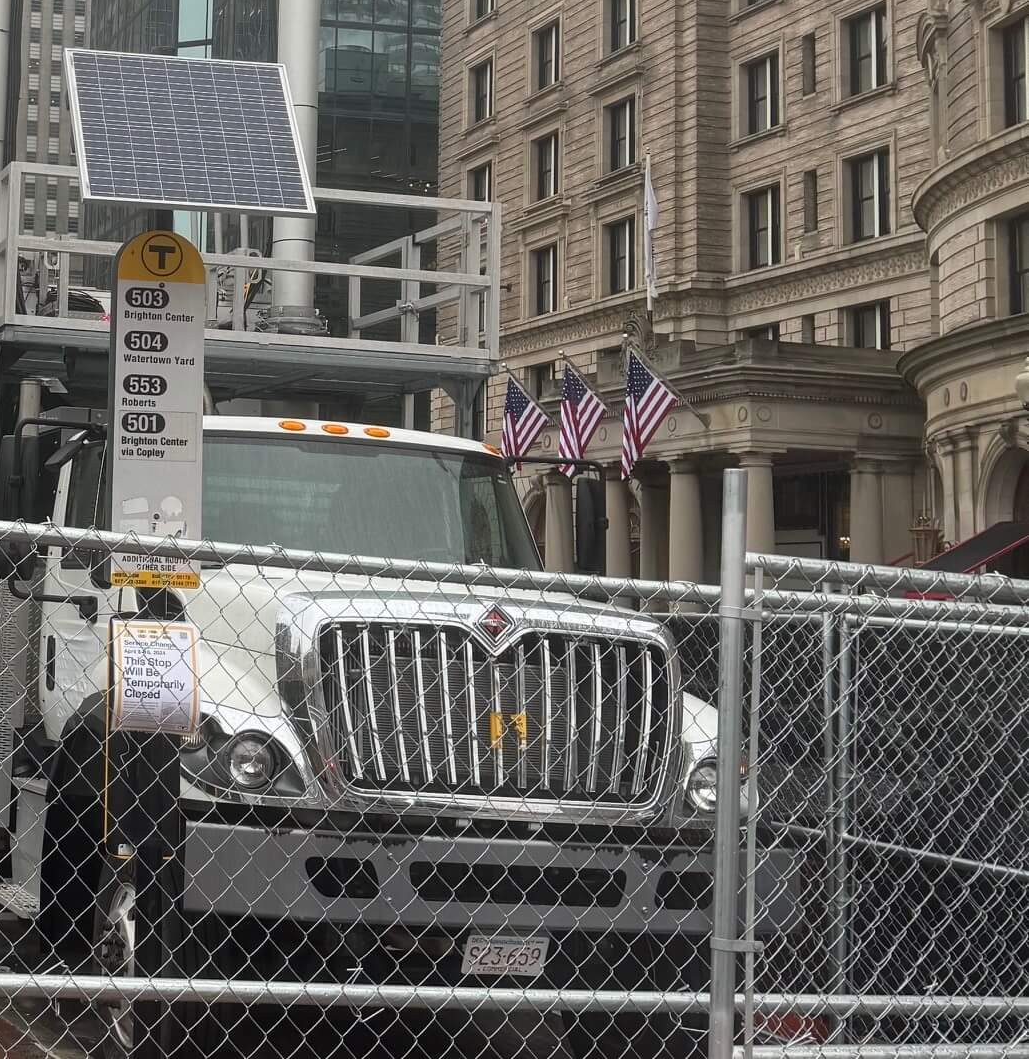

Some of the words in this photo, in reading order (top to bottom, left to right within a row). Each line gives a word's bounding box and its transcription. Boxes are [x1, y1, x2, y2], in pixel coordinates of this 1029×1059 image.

[131, 292, 164, 307] 503
[124, 310, 162, 321] Brighton
[165, 314, 194, 322] Center
[130, 334, 162, 349] 504
[123, 354, 171, 365] Watertown
[174, 356, 195, 366] Yard
[129, 378, 161, 393] 553
[122, 398, 156, 407] Roberts
[127, 415, 158, 432] 501
[121, 436, 158, 447] Brighton
[160, 438, 188, 447] Center
[121, 448, 134, 456] via
[136, 448, 165, 458] Copley
[122, 555, 162, 564] ADDITIONAL
[124, 656, 145, 666] This
[147, 657, 172, 668] Stop
[124, 667, 143, 676] Will
[146, 668, 160, 677] Be
[124, 677, 185, 691] Temporarily
[124, 689, 161, 699] Closed
